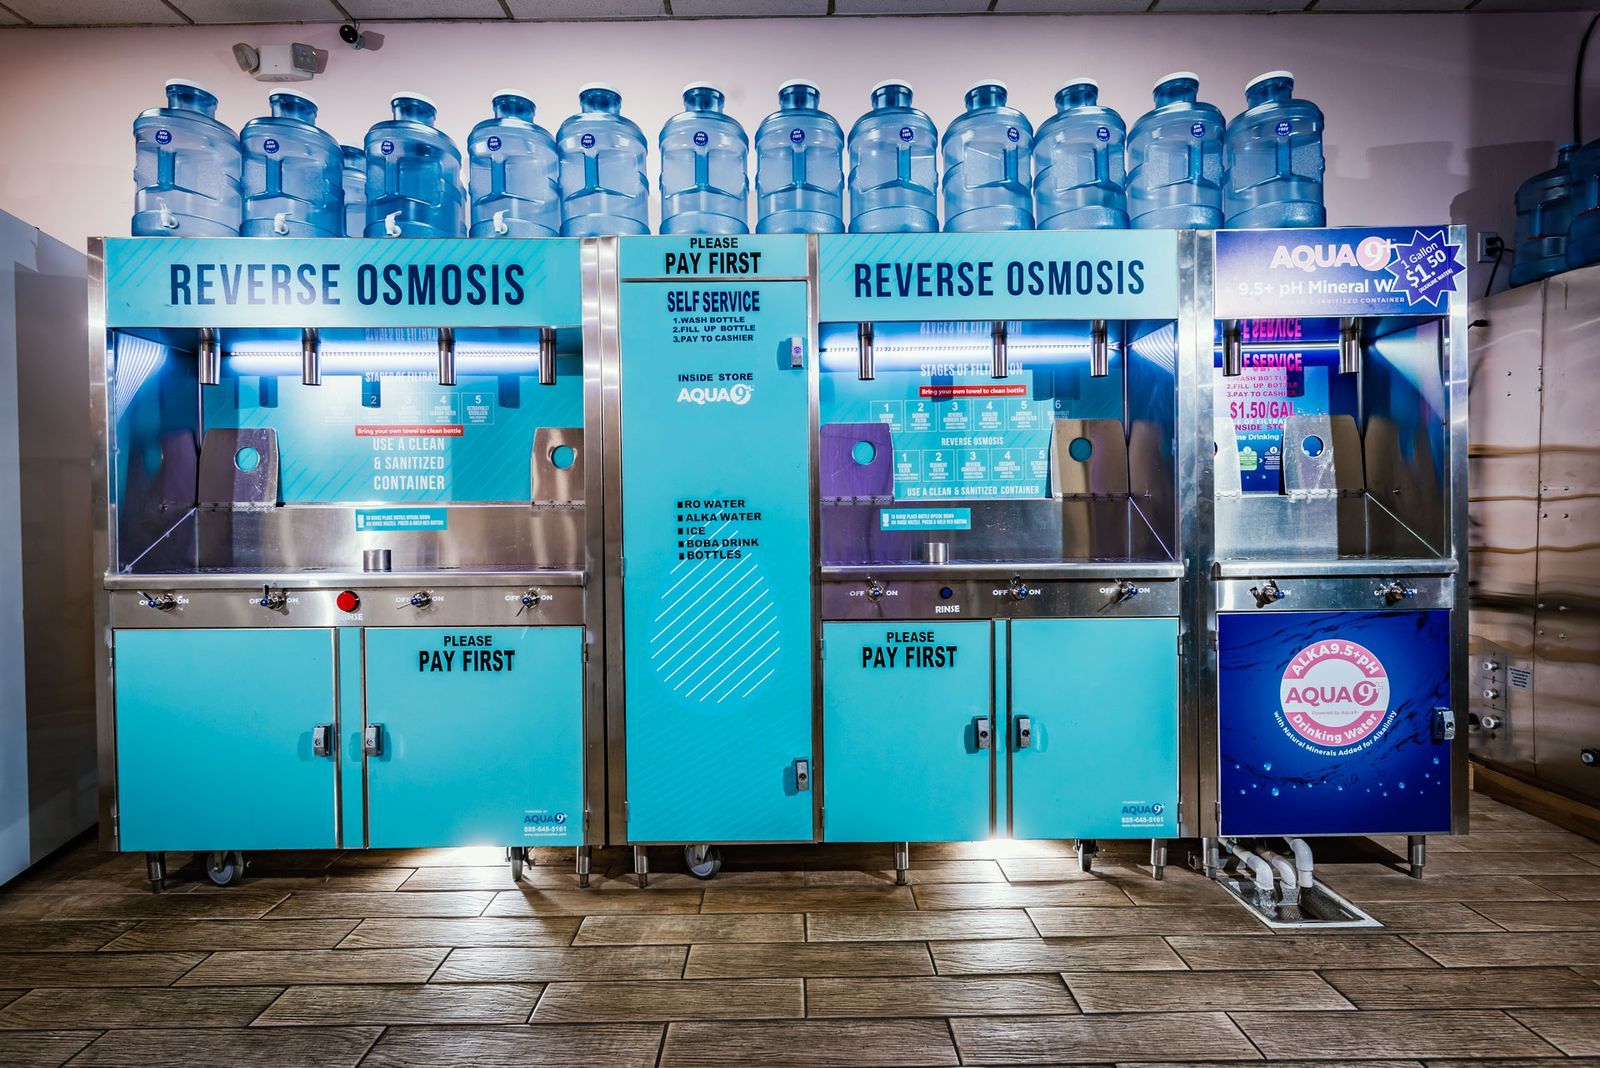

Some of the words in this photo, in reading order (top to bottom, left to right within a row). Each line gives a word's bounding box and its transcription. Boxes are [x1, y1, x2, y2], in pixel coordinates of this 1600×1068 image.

[690, 238, 739, 249] PLEASE
[1401, 260, 1410, 270] 1
[1409, 242, 1438, 263] Gallon
[665, 252, 702, 274] PAY
[709, 252, 762, 274] FIRST
[854, 262, 994, 297] REVERSE
[1007, 260, 1145, 296] OSMOSIS
[170, 264, 340, 305] REVERSE
[357, 264, 525, 305] OSMOSIS
[1280, 281, 1302, 296] pH
[1308, 280, 1369, 294] Mineral
[667, 291, 699, 312] SELF
[702, 291, 760, 312] SERVICE
[1252, 353, 1303, 372] SERVICE
[920, 363, 955, 377] STAGES
[957, 363, 968, 376] OF
[678, 374, 713, 382] INSIDE
[718, 373, 753, 382] STORE
[371, 396, 376, 404] 2
[440, 395, 446, 404] 4
[475, 395, 481, 404] 5
[1055, 400, 1061, 409] 6
[884, 403, 889, 412] 1
[918, 402, 924, 412] 2
[952, 402, 958, 411] 3
[986, 401, 993, 410] 4
[1021, 401, 1027, 409] 5
[1230, 401, 1296, 419] $1.50/GAL
[373, 438, 394, 451] USE
[398, 438, 405, 451] A
[409, 438, 445, 450] CLEAN
[941, 438, 972, 446] REVERSE
[974, 437, 1003, 445] OSMOSIS
[902, 453, 906, 462] 1
[936, 452, 942, 462] 2
[970, 452, 976, 460] 3
[1004, 451, 1011, 460] 4
[1039, 450, 1045, 459] 5
[374, 457, 381, 470] &
[385, 457, 444, 469] SANITIZED
[374, 476, 445, 490] CONTAINER
[907, 487, 920, 496] USE
[930, 487, 951, 496] CLEAN
[954, 487, 959, 495] &
[961, 486, 997, 495] SANITIZED
[1001, 485, 1039, 494] CONTAINER
[684, 500, 700, 508] RO
[704, 500, 745, 508] WATER
[686, 513, 717, 522] ALKA
[720, 513, 762, 521] WATER
[686, 527, 706, 535] ICE
[686, 539, 719, 548] BOBA
[722, 538, 759, 547] DRINK
[687, 550, 741, 560] BOTTLES
[444, 636, 492, 646] PLEASE
[887, 632, 934, 642] PLEASE
[419, 651, 455, 672] PAY
[463, 650, 515, 672] FIRST
[862, 647, 898, 668] PAY
[906, 646, 957, 668] FIRST
[1273, 711, 1285, 728] with
[1283, 727, 1305, 748] Natural
[1306, 744, 1337, 756] Minerals
[1338, 745, 1363, 756] Added
[1363, 739, 1373, 748] for
[1372, 710, 1397, 742] Alkalinity
[1292, 714, 1342, 744] Drinking
[1344, 713, 1378, 740] Water
